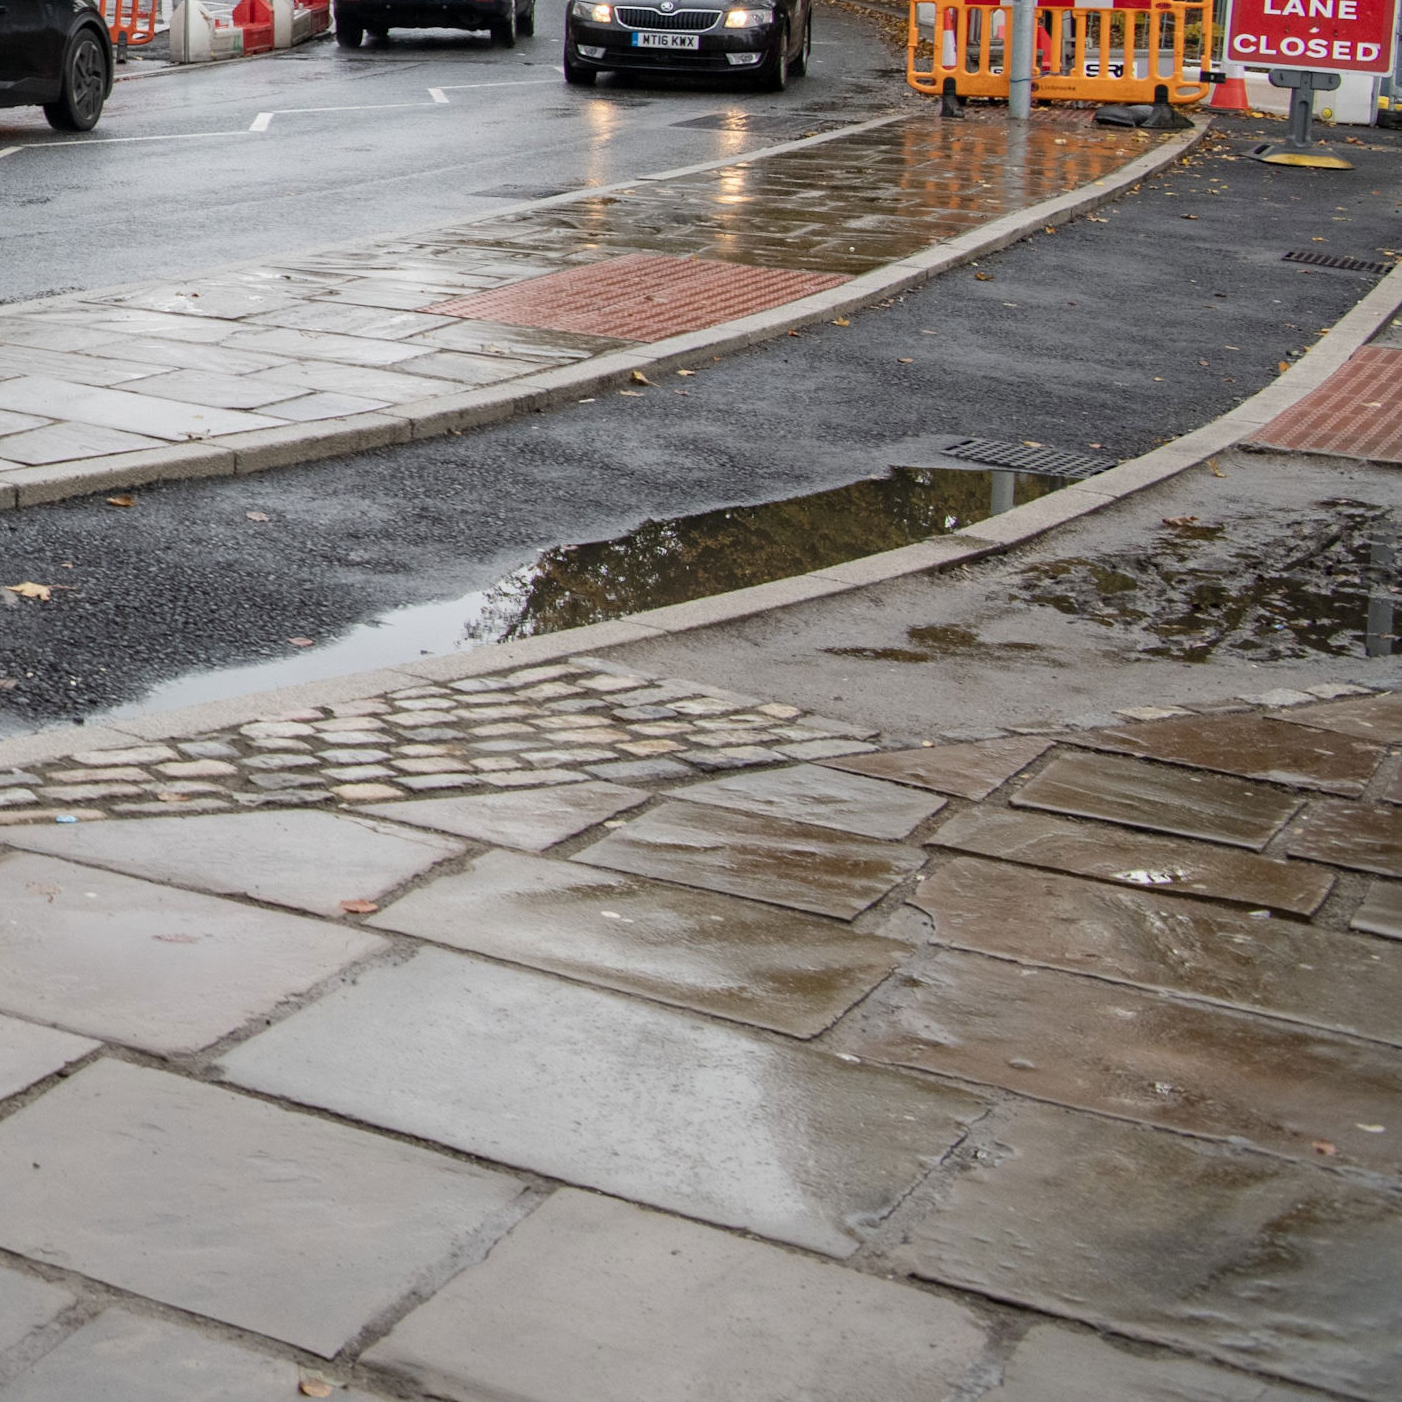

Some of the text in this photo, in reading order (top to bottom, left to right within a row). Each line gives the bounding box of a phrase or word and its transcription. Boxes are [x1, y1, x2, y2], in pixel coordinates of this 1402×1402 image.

[642, 34, 694, 47] MT16 KWX
[1233, 33, 1381, 62] CLOSED
